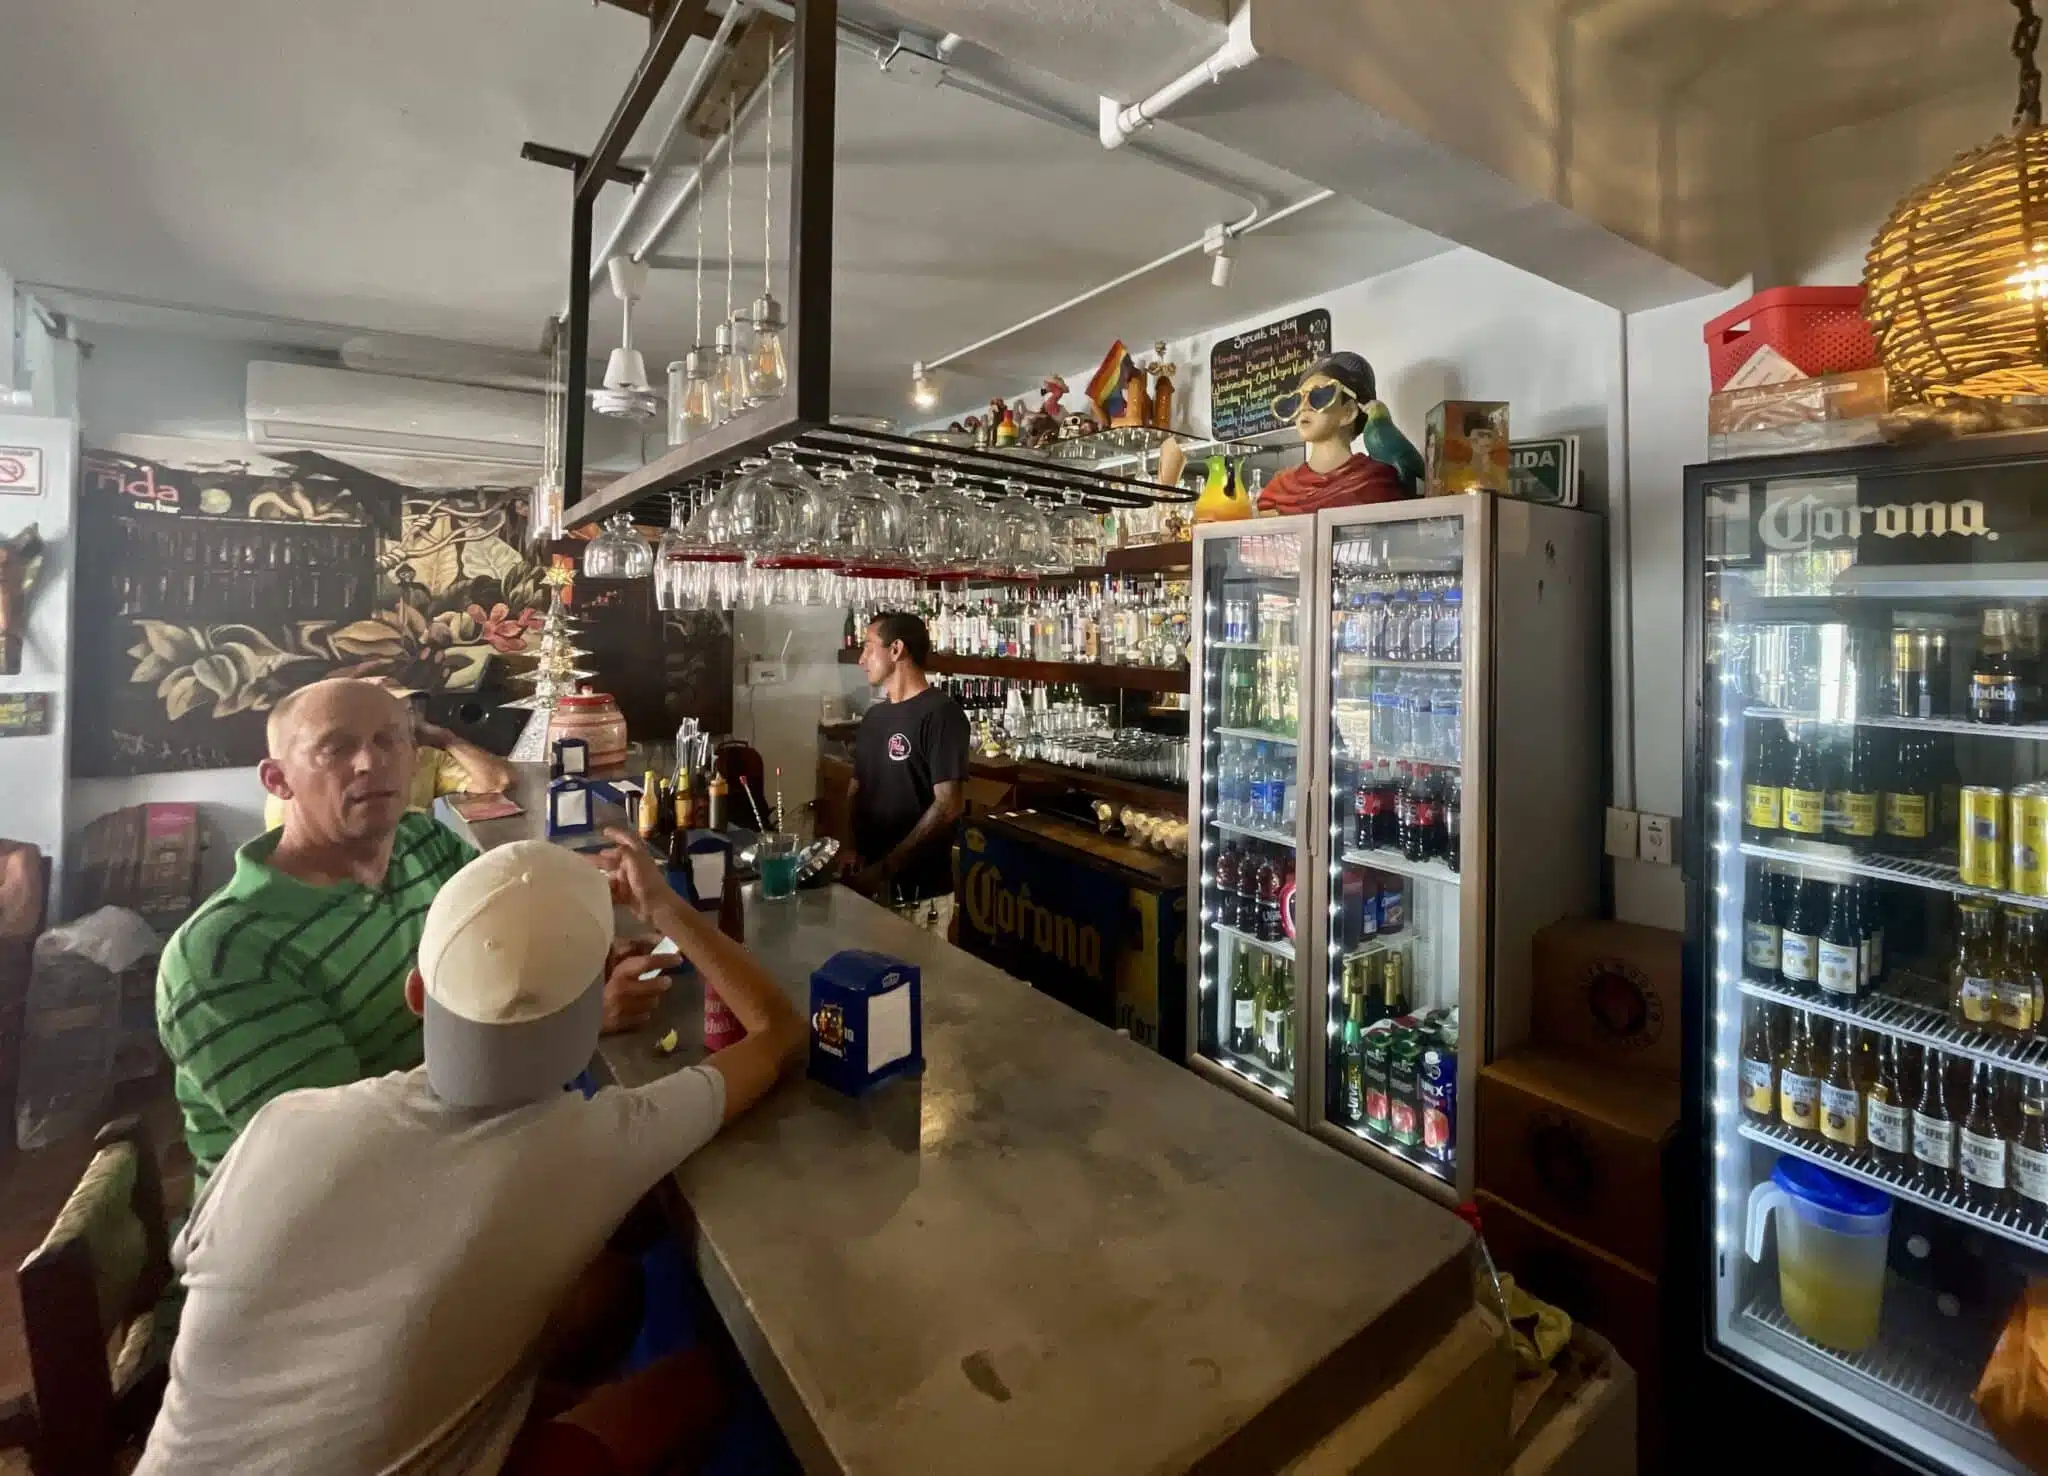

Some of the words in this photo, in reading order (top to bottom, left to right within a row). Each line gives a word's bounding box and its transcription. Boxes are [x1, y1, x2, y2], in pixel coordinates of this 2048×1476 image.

[1234, 328, 1267, 350] Specials
[1270, 323, 1280, 339] by
[1281, 319, 1298, 337] day
[1508, 449, 1555, 468] IDA
[1758, 492, 1992, 551] Corona
[966, 860, 1103, 981] Corona
